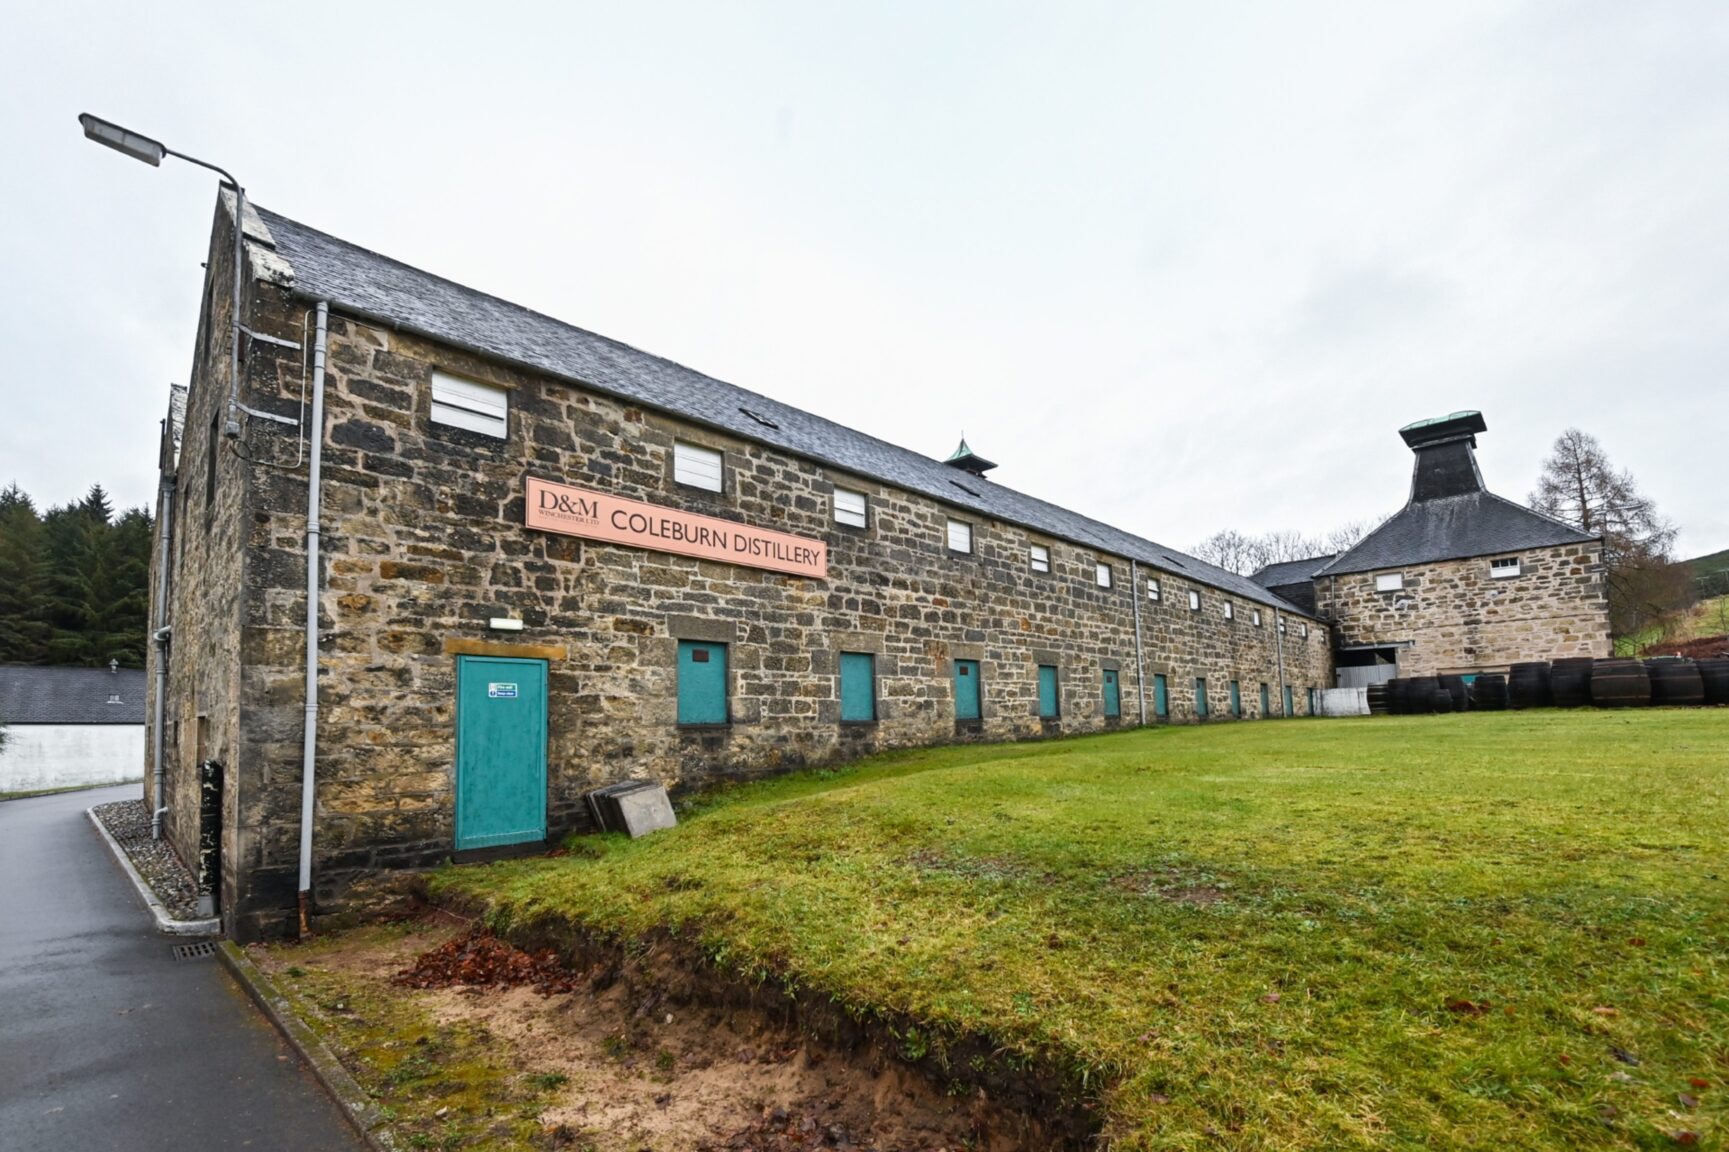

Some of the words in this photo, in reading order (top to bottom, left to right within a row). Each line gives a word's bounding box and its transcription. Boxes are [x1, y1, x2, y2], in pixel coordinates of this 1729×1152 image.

[538, 489, 599, 519] D&M
[538, 508, 585, 523] WINCHESTER
[611, 509, 728, 549] COLEBURN
[734, 534, 821, 567] DISTILLERY
